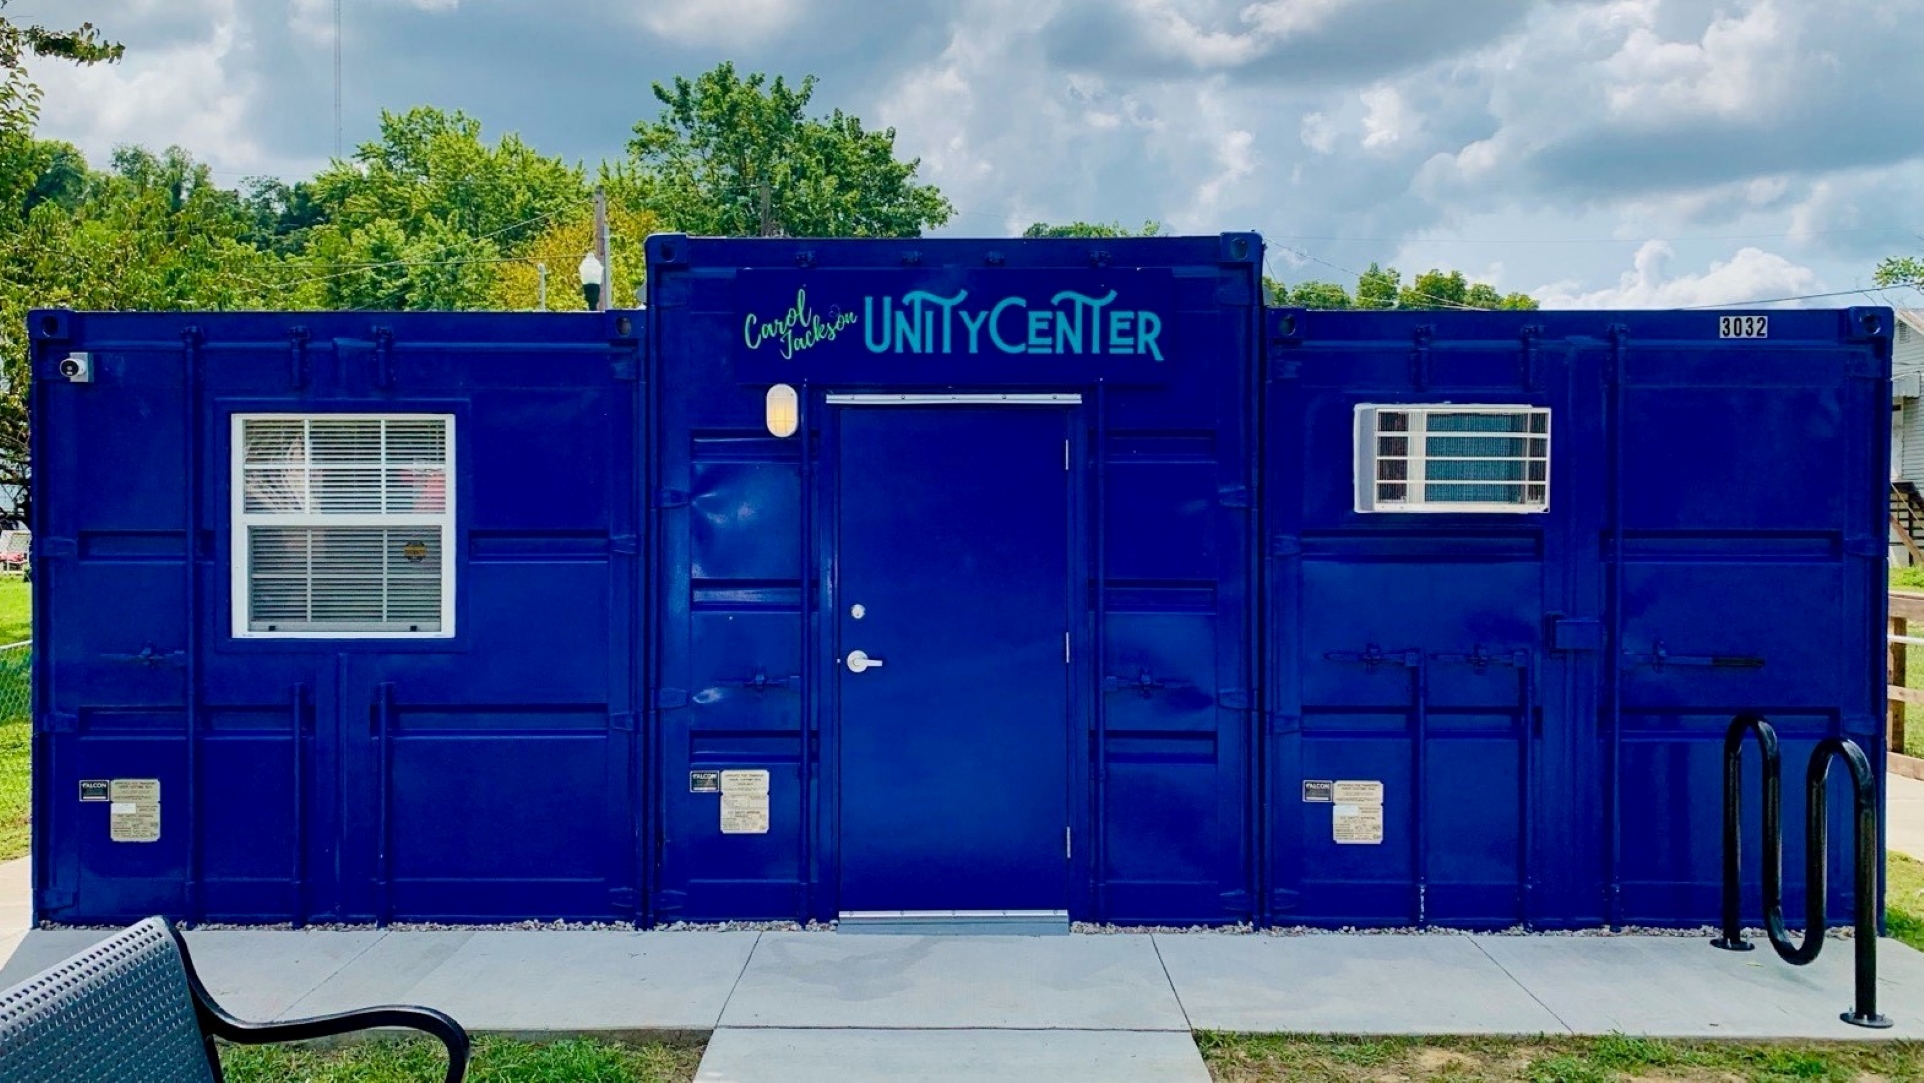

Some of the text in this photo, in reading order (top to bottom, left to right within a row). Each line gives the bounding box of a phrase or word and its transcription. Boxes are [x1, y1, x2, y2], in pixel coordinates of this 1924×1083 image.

[744, 288, 812, 350] Carol
[779, 311, 858, 360] Jackson
[1722, 316, 1767, 337] 3032
